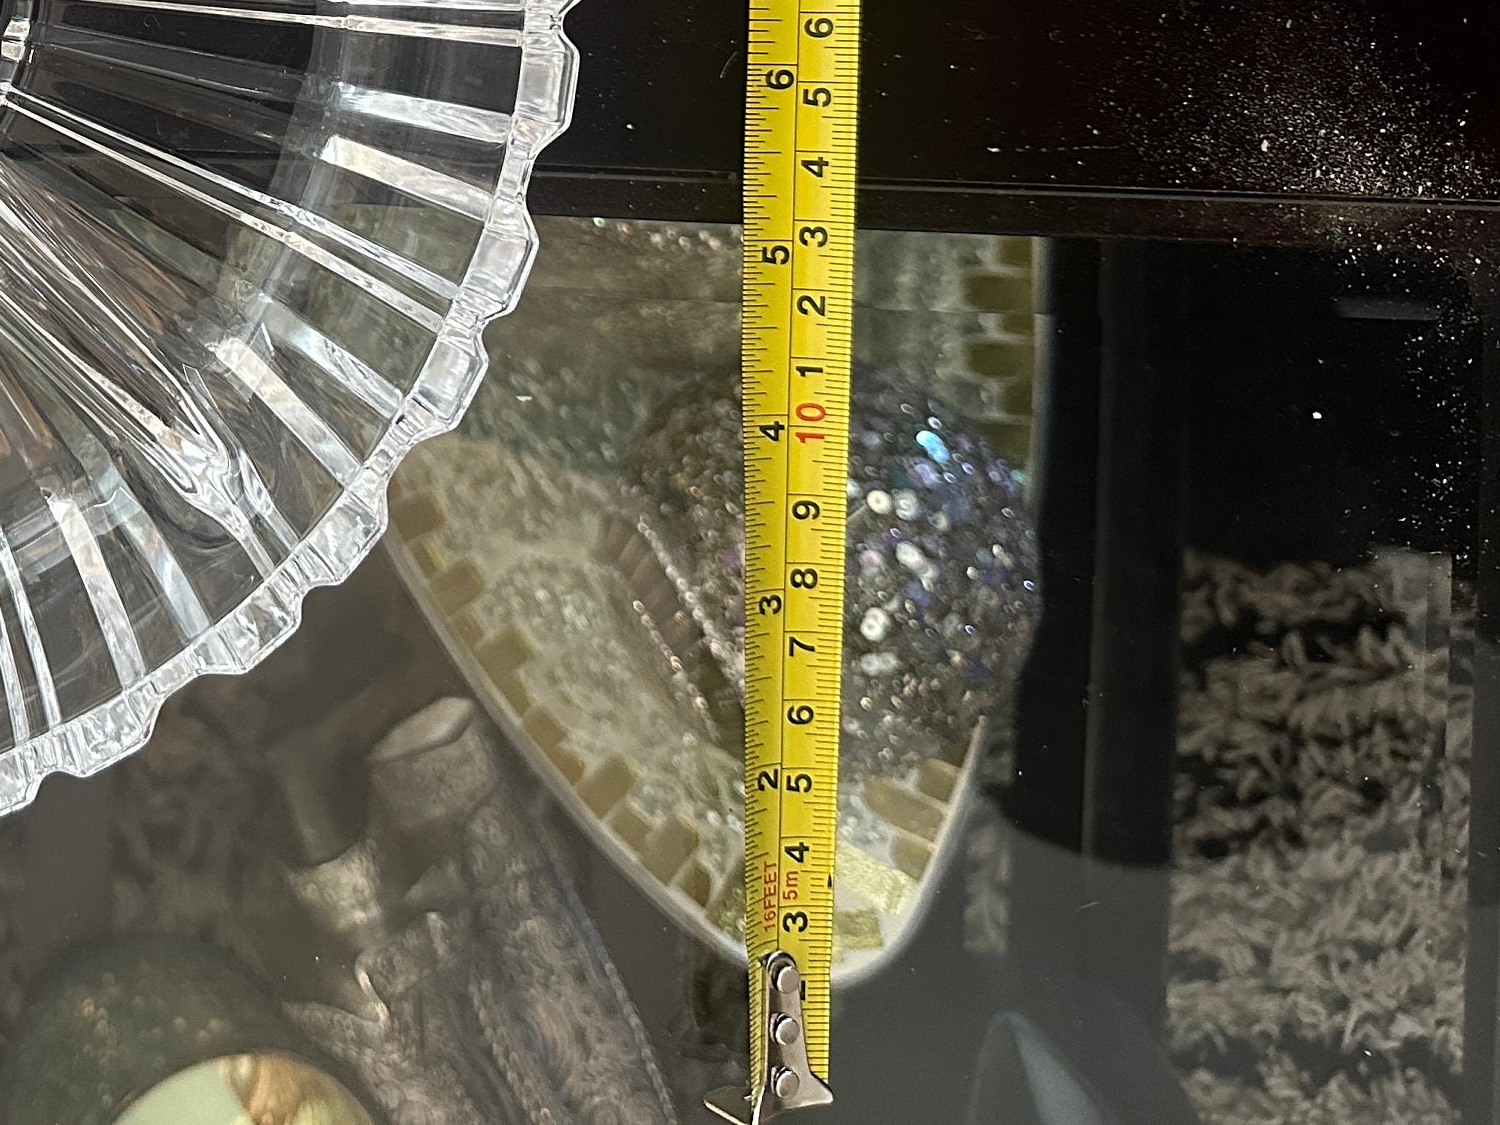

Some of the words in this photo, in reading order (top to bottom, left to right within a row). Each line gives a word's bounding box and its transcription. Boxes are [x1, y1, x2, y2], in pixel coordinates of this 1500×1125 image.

[804, 17, 833, 38] 6
[765, 68, 794, 90] 6
[802, 87, 832, 108] 5
[801, 156, 829, 178] 4
[798, 225, 828, 247] 3
[761, 244, 790, 265] 5
[796, 295, 826, 316] 2
[795, 365, 824, 378] 1
[759, 420, 785, 441] 4
[792, 499, 821, 520] 9
[790, 567, 819, 590] 8
[759, 595, 782, 616] 3
[788, 636, 816, 657] 7
[787, 704, 815, 726] 6
[757, 768, 780, 792] 2
[785, 773, 813, 794] 5
[784, 842, 810, 864] 4
[783, 870, 799, 901] 5m
[763, 862, 778, 932] 16FEET
[782, 911, 809, 933] 3
